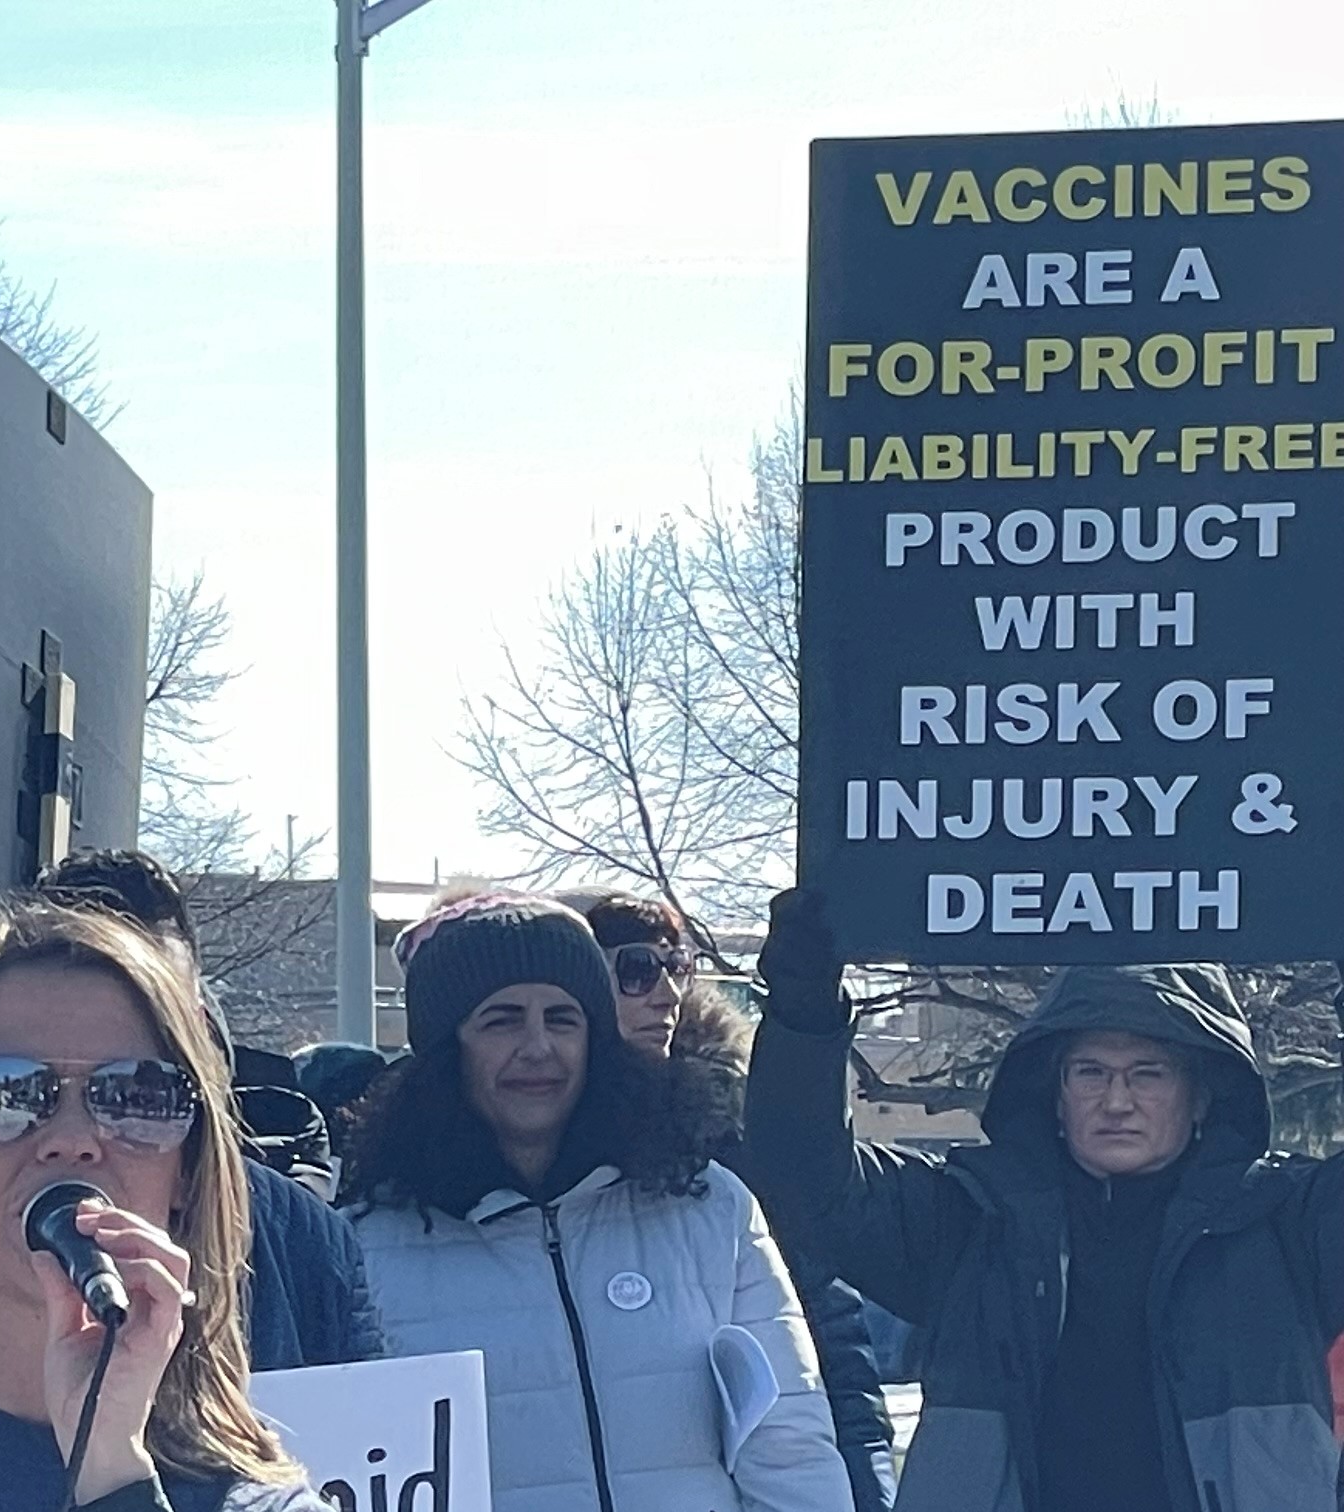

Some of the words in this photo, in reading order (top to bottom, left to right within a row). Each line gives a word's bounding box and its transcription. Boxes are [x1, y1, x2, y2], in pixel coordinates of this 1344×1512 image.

[876, 157, 1310, 225] VACCINES
[963, 250, 1132, 308] ARE
[1161, 247, 1220, 301] A
[829, 328, 1334, 397] FOR-PROFIT
[809, 423, 1344, 482] LIABILITY-FREE
[886, 502, 1295, 566] PRODUCT
[975, 592, 1194, 650] WITH
[901, 682, 1121, 744] RISK
[1154, 679, 1273, 740] OF
[847, 776, 1198, 839] INJURY
[1232, 773, 1298, 833] &
[928, 870, 1238, 932] DEATH
